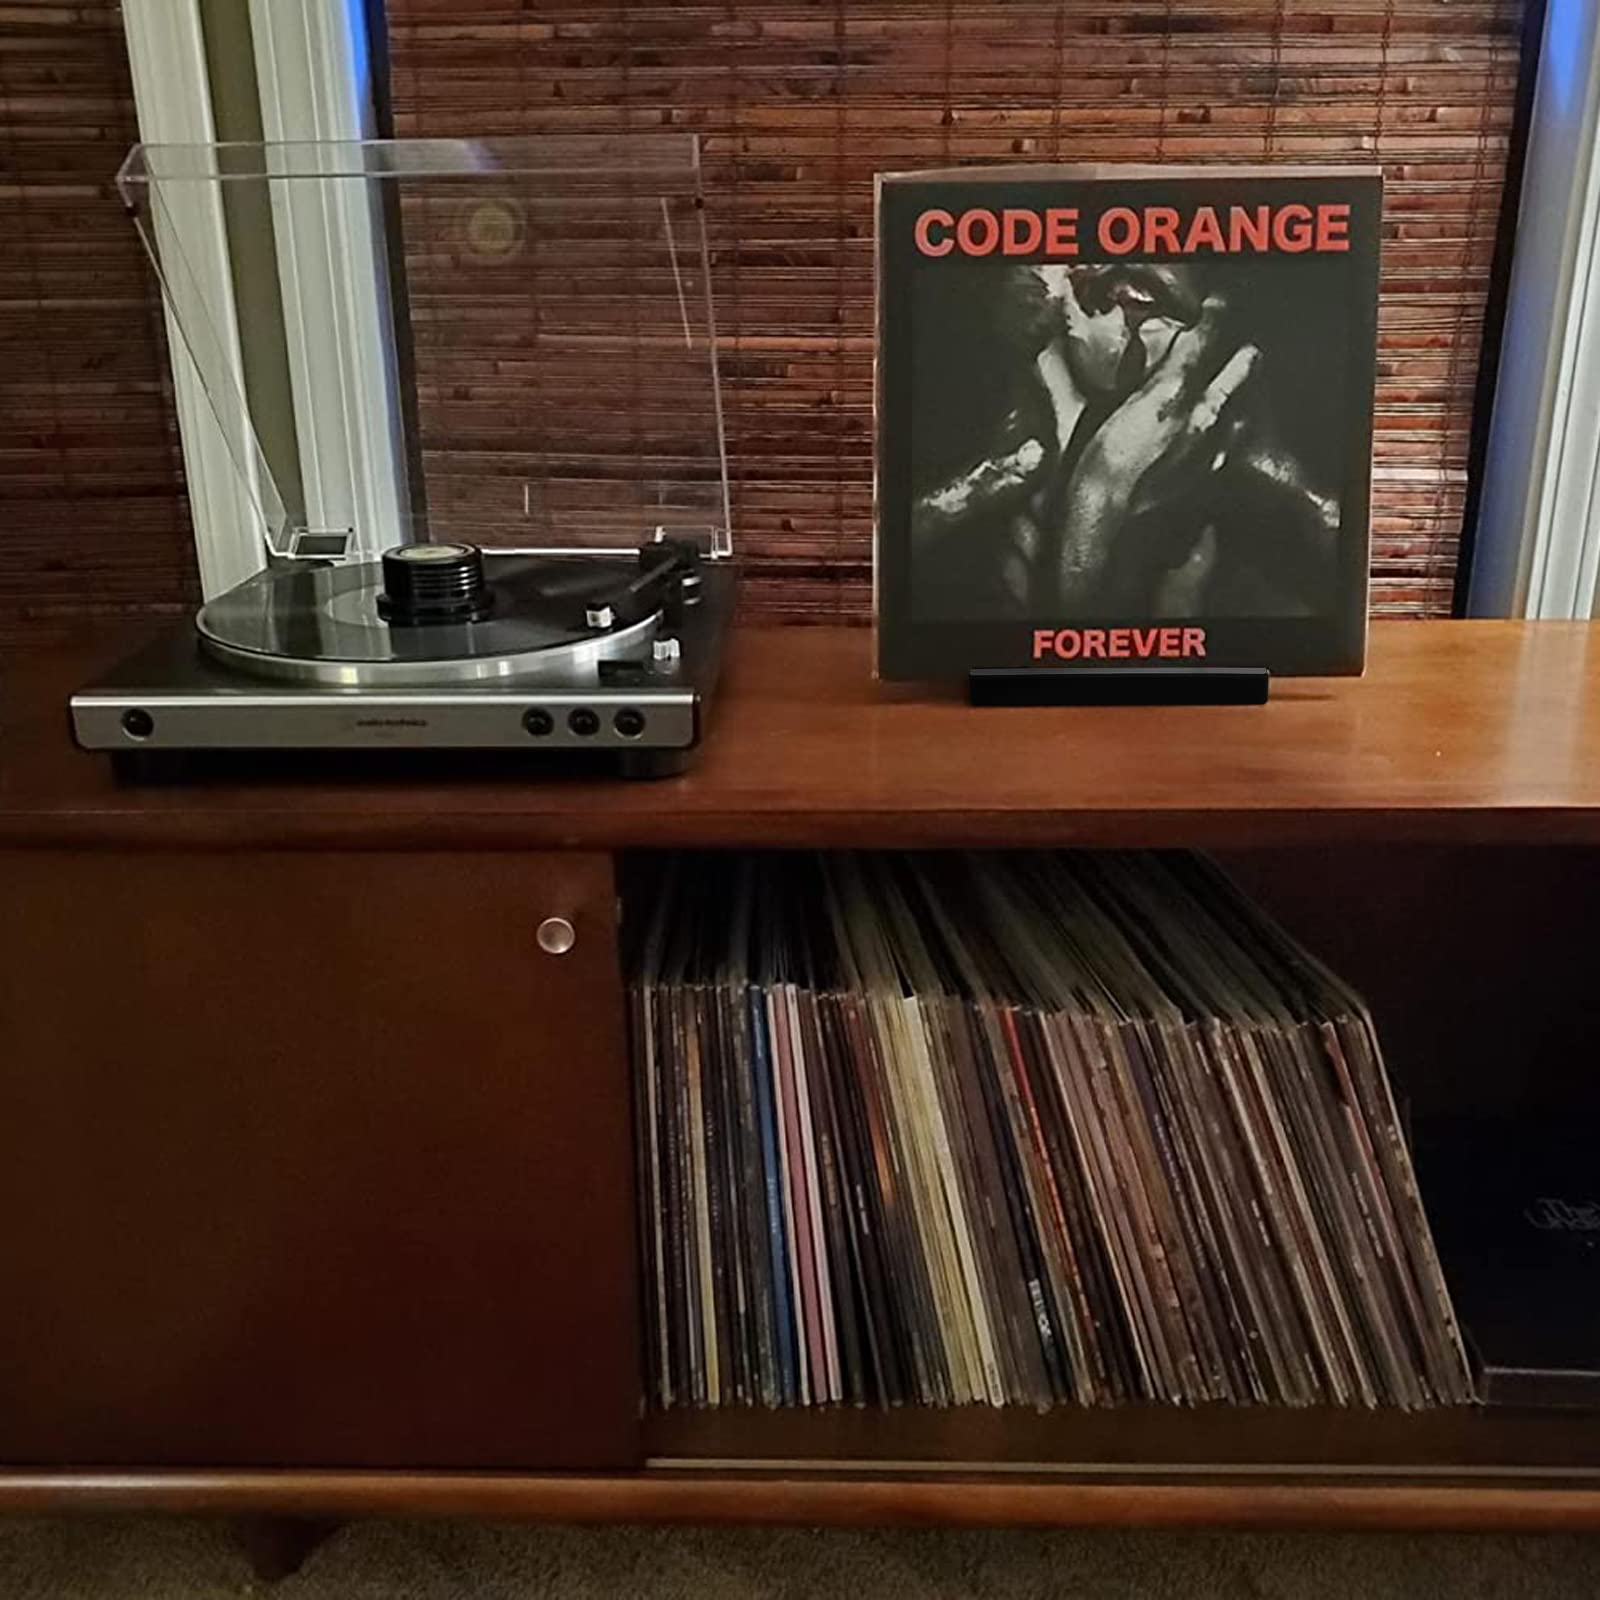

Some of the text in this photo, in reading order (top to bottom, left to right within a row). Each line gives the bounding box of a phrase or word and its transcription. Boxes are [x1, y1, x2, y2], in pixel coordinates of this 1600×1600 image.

[914, 204, 1351, 257] CODE ORANGE
[1033, 627, 1207, 660] FOREVER
